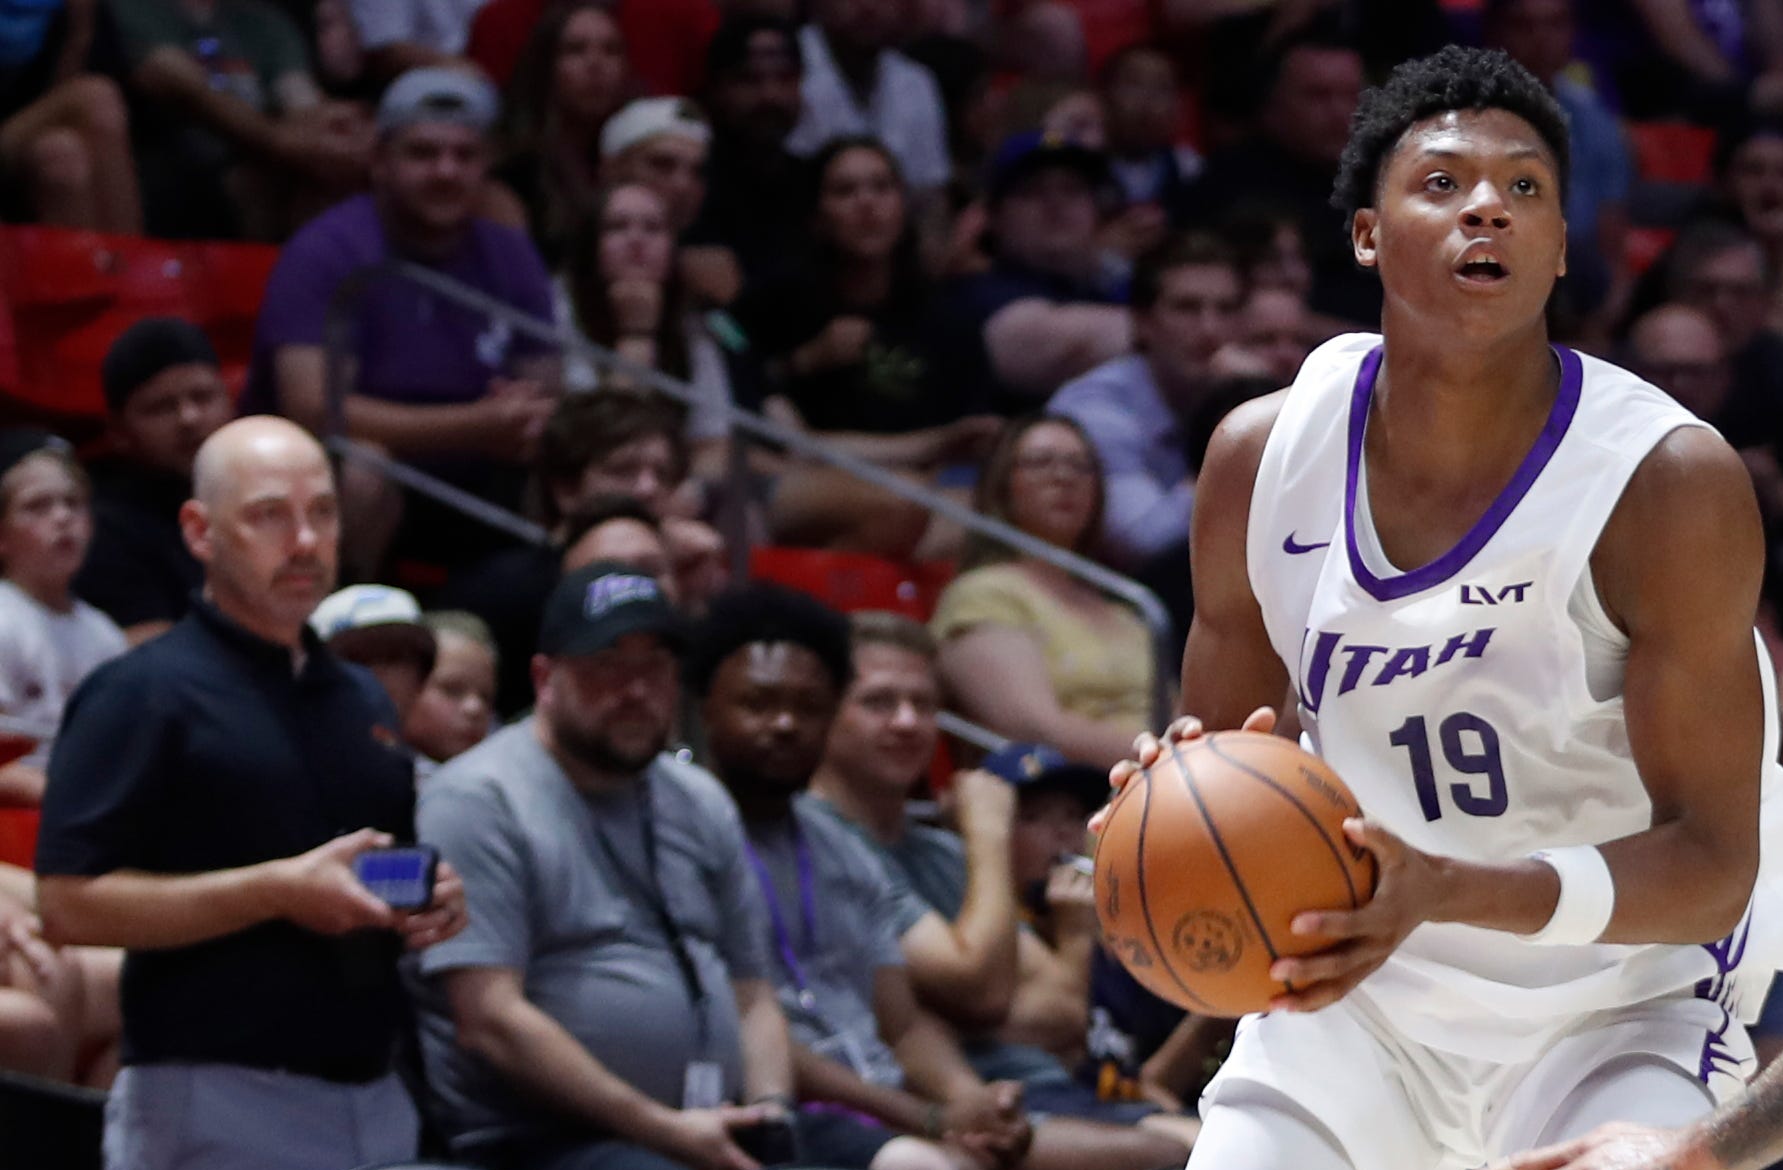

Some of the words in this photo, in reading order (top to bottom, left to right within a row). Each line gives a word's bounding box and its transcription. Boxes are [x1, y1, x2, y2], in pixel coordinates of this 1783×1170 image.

[1459, 580, 1535, 606] LVT
[1299, 626, 1498, 716] UTAH
[1388, 711, 1509, 823] 19
